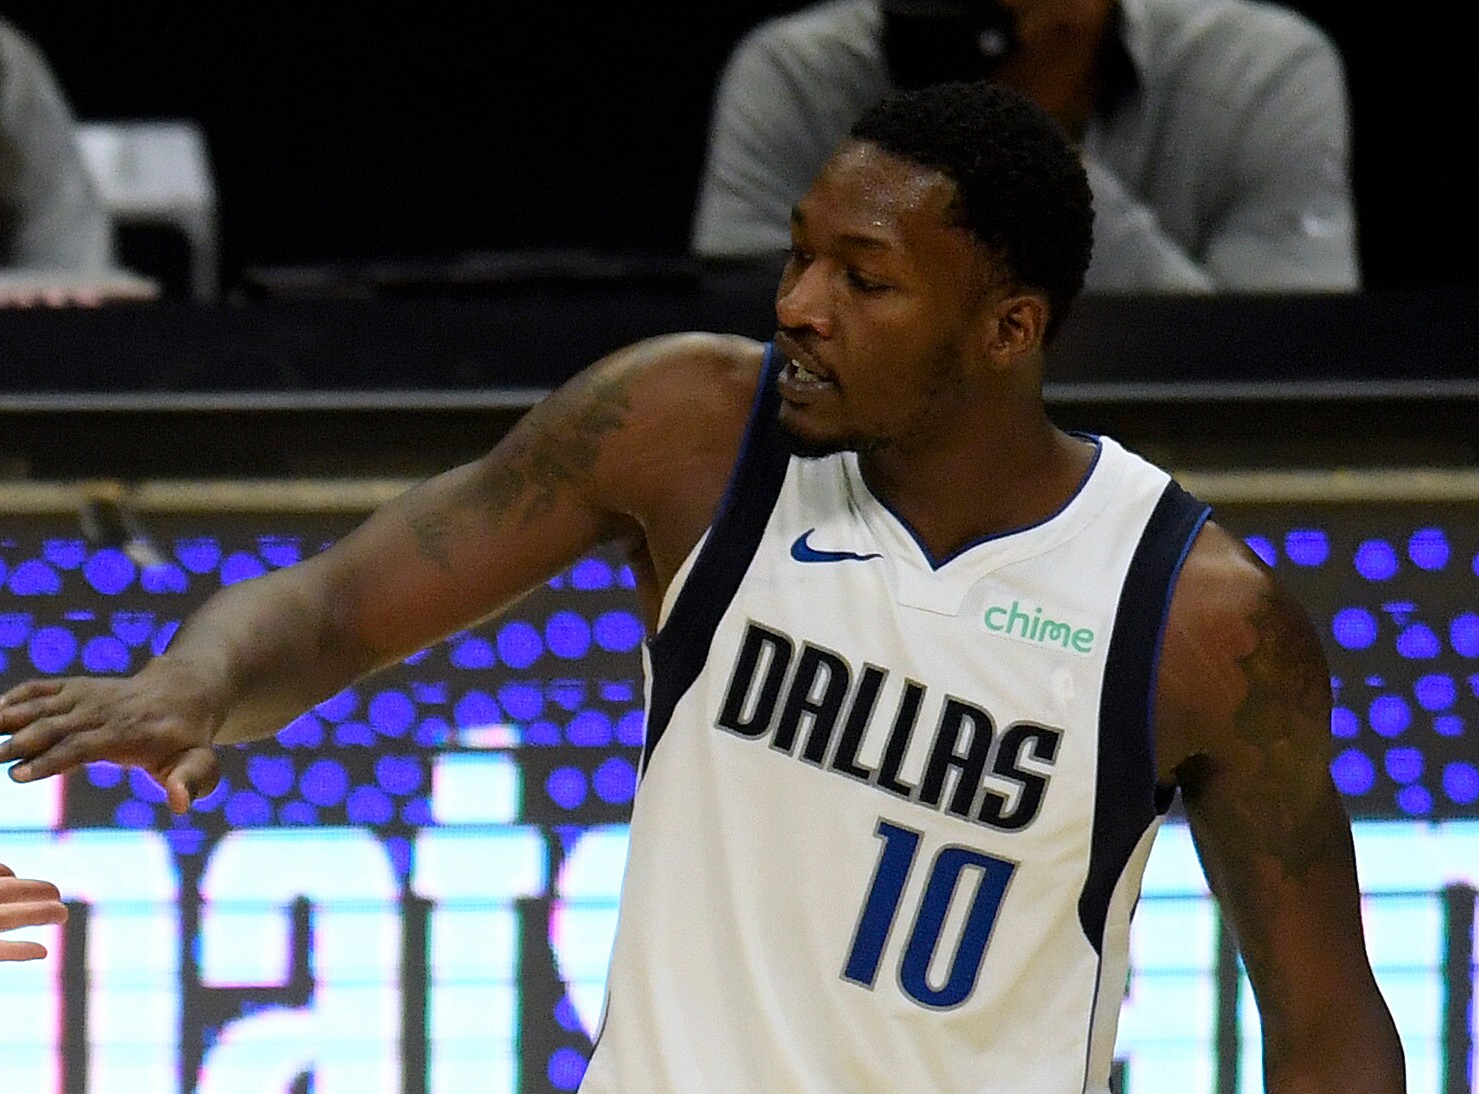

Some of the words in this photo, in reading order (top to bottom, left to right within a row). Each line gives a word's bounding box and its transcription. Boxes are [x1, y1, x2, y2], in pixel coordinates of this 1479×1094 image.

[984, 601, 1095, 653] chime
[715, 618, 1064, 833] DALLAS
[839, 816, 1021, 1012] 10
